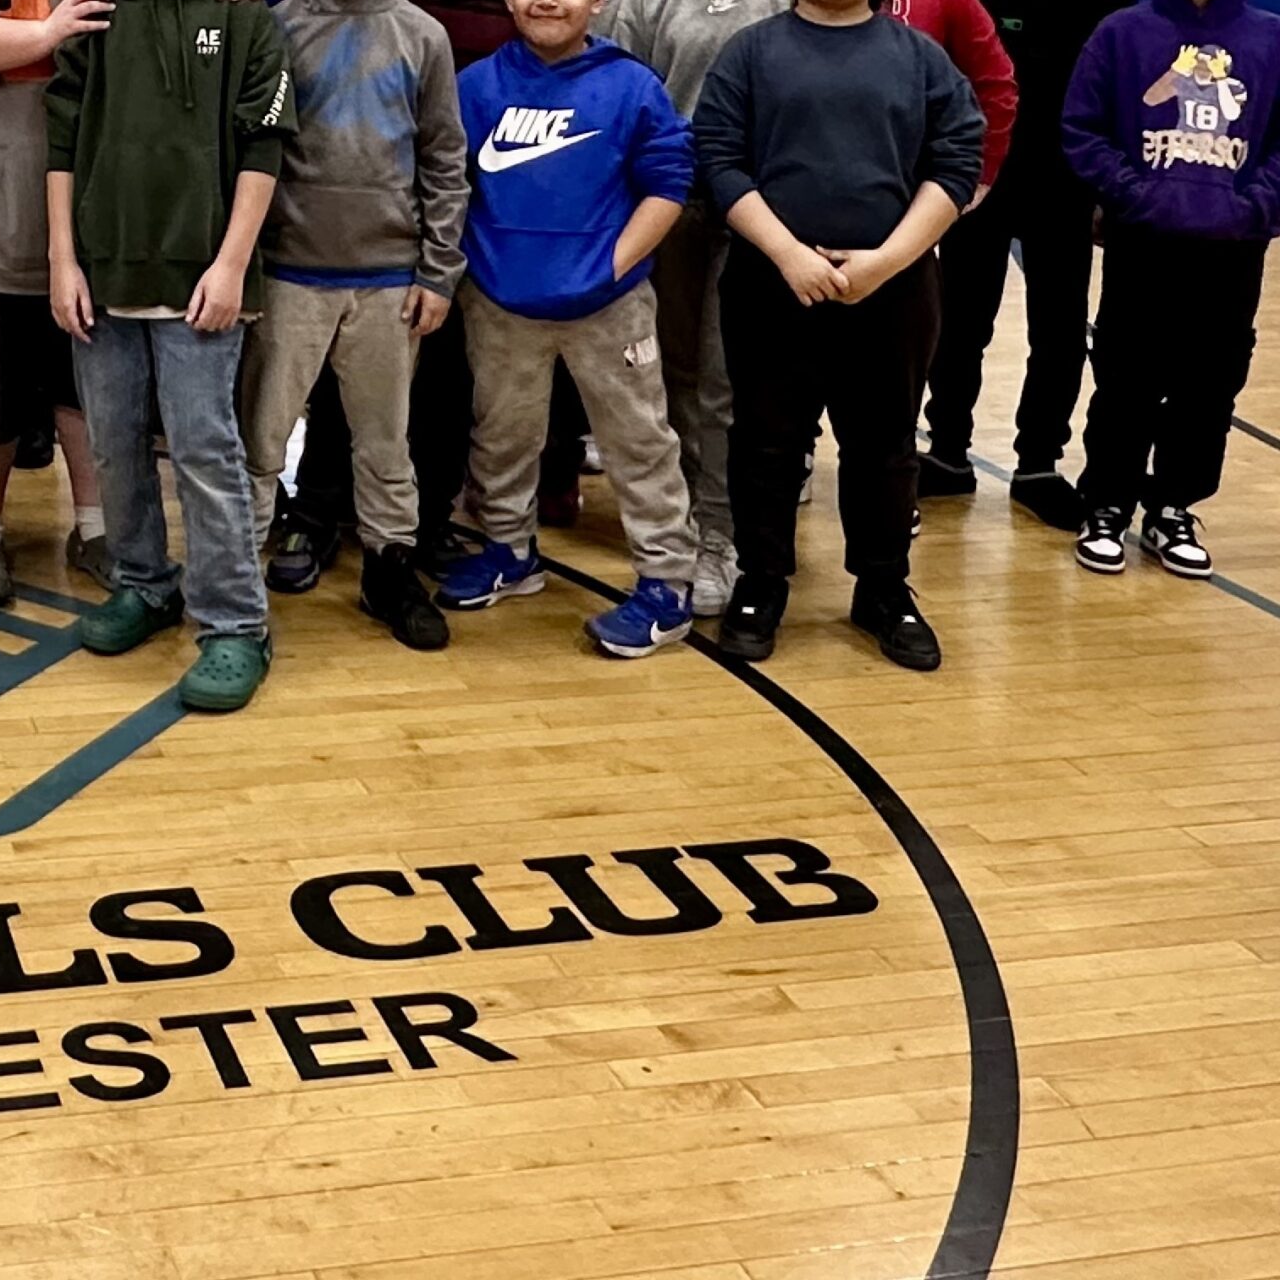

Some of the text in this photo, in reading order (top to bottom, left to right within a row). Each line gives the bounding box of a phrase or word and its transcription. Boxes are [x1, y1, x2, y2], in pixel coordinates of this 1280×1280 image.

[195, 28, 221, 46] AE
[196, 46, 220, 55] 1977
[493, 106, 575, 145] NIKE
[1183, 99, 1219, 131] 18
[290, 838, 879, 961] CLUB
